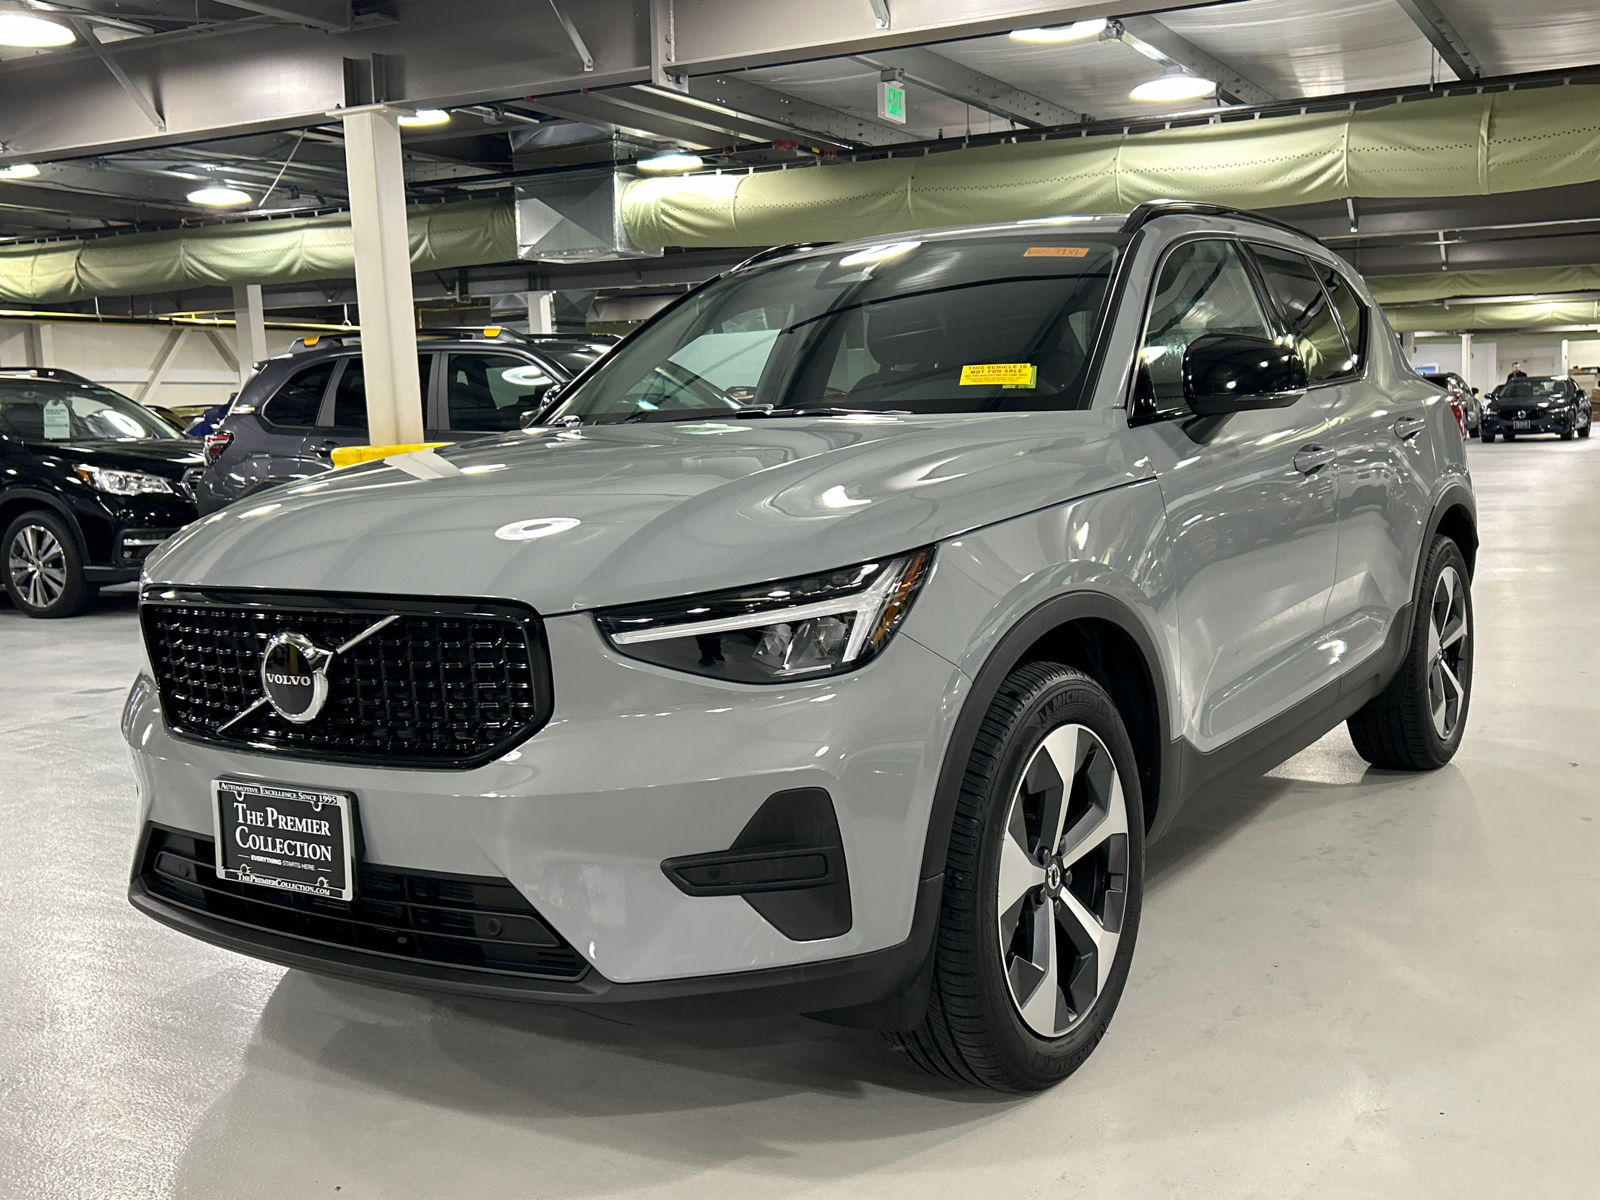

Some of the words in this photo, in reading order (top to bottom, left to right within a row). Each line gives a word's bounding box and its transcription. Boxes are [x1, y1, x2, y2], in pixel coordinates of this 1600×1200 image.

[266, 673, 311, 686] VOLVO
[319, 795, 336, 804] 1995
[234, 802, 264, 826] THE
[266, 807, 331, 836] PREMIER
[236, 826, 332, 862] COLLECTION
[250, 854, 282, 865] EVERYTHING
